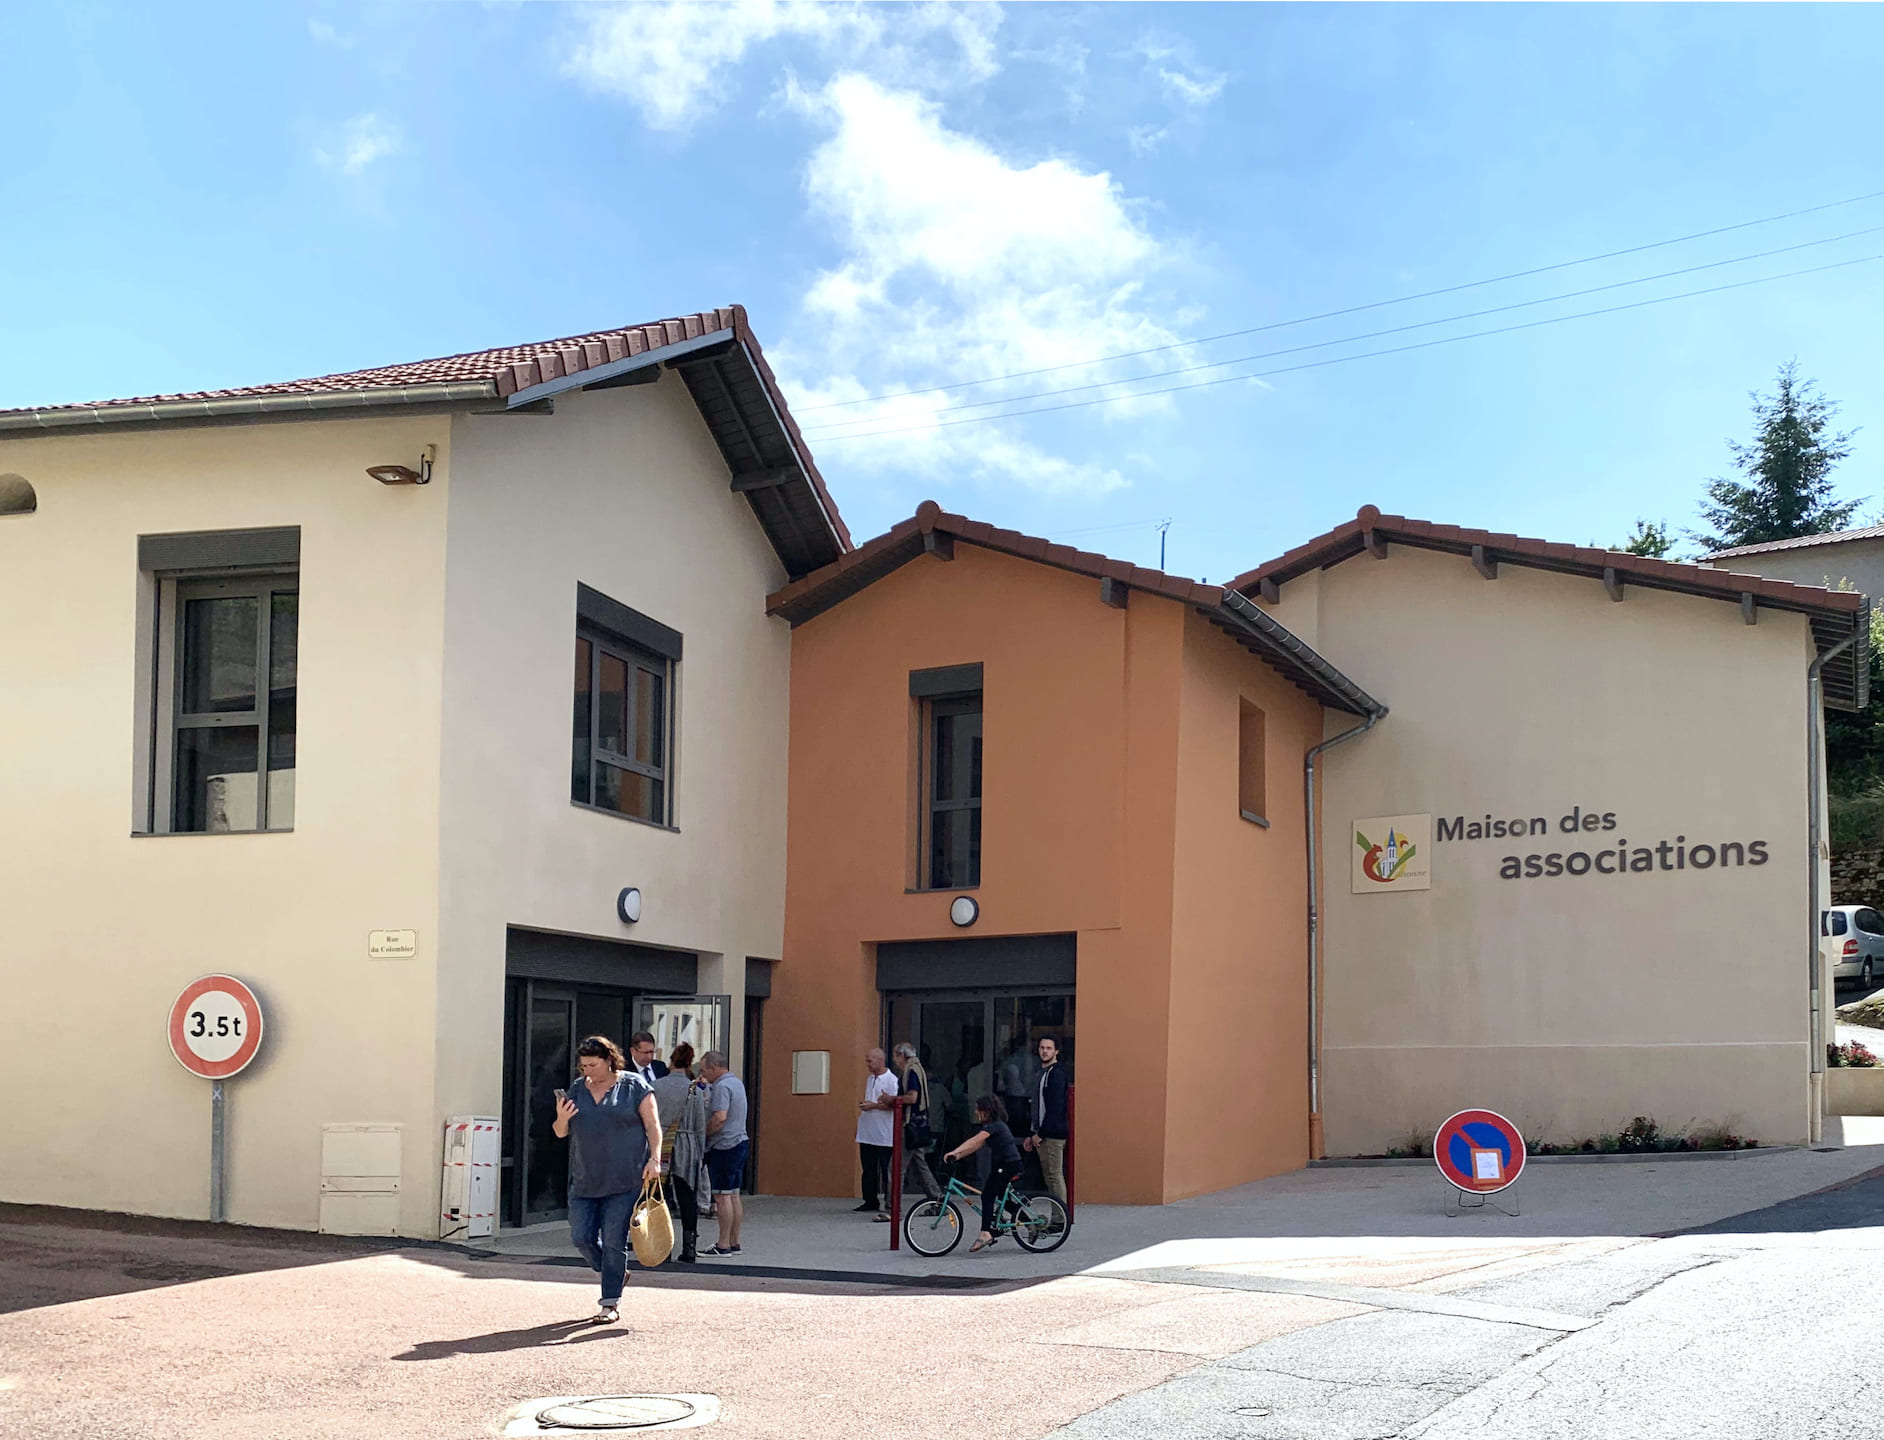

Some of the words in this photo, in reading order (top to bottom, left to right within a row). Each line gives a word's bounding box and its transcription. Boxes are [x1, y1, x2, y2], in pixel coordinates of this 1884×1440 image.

[1436, 815, 1547, 842] Maison
[1559, 806, 1617, 833] des
[1500, 835, 1769, 880] associations
